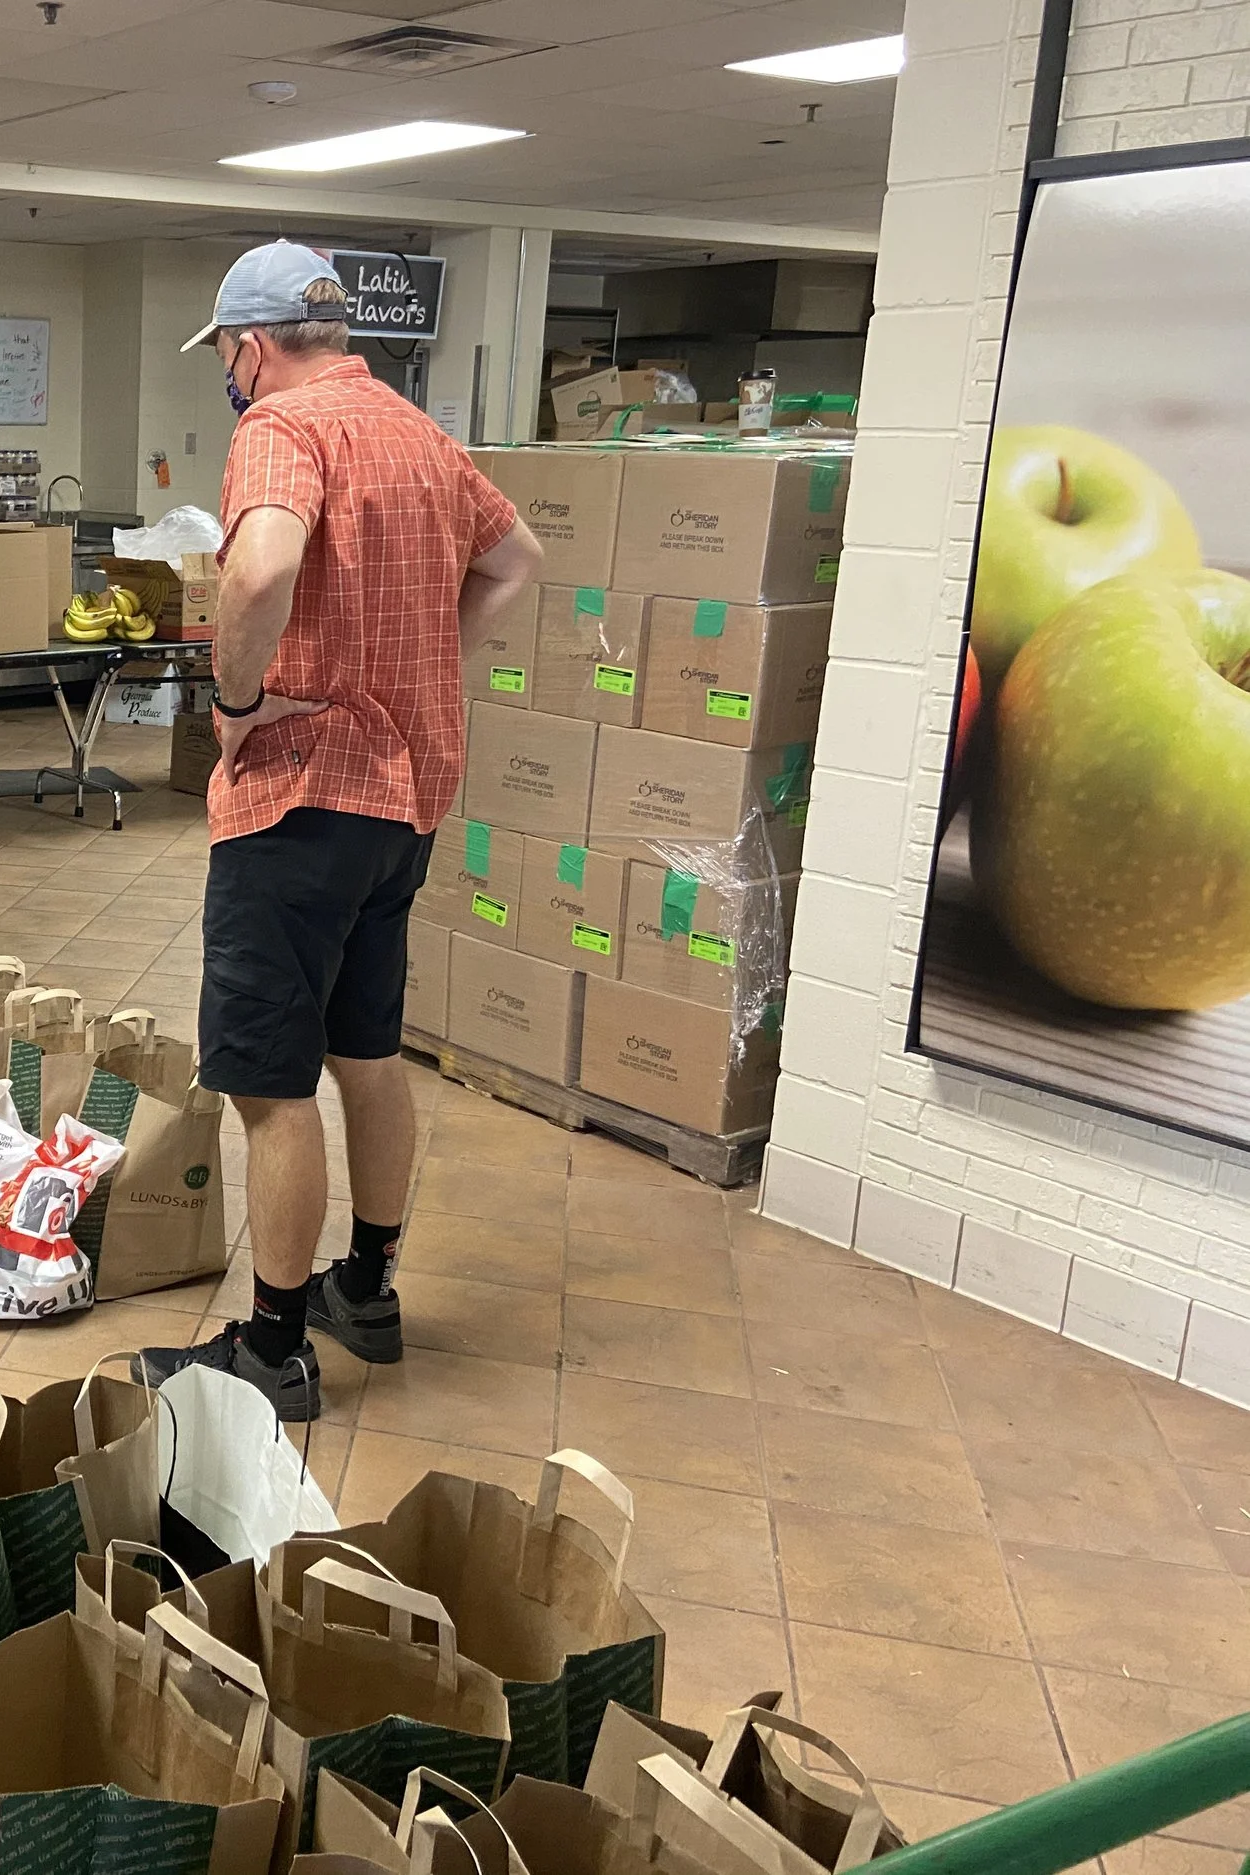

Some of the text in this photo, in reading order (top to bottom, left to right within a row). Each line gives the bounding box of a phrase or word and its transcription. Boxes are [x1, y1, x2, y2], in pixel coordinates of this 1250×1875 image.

[549, 510, 569, 518] STORY
[685, 513, 719, 522] SHERIDAN
[694, 521, 718, 530] STORY
[121, 685, 153, 706] Georgia
[127, 701, 162, 718] Produce
[652, 785, 685, 798] SHERIDAN
[662, 794, 685, 804] STORY
